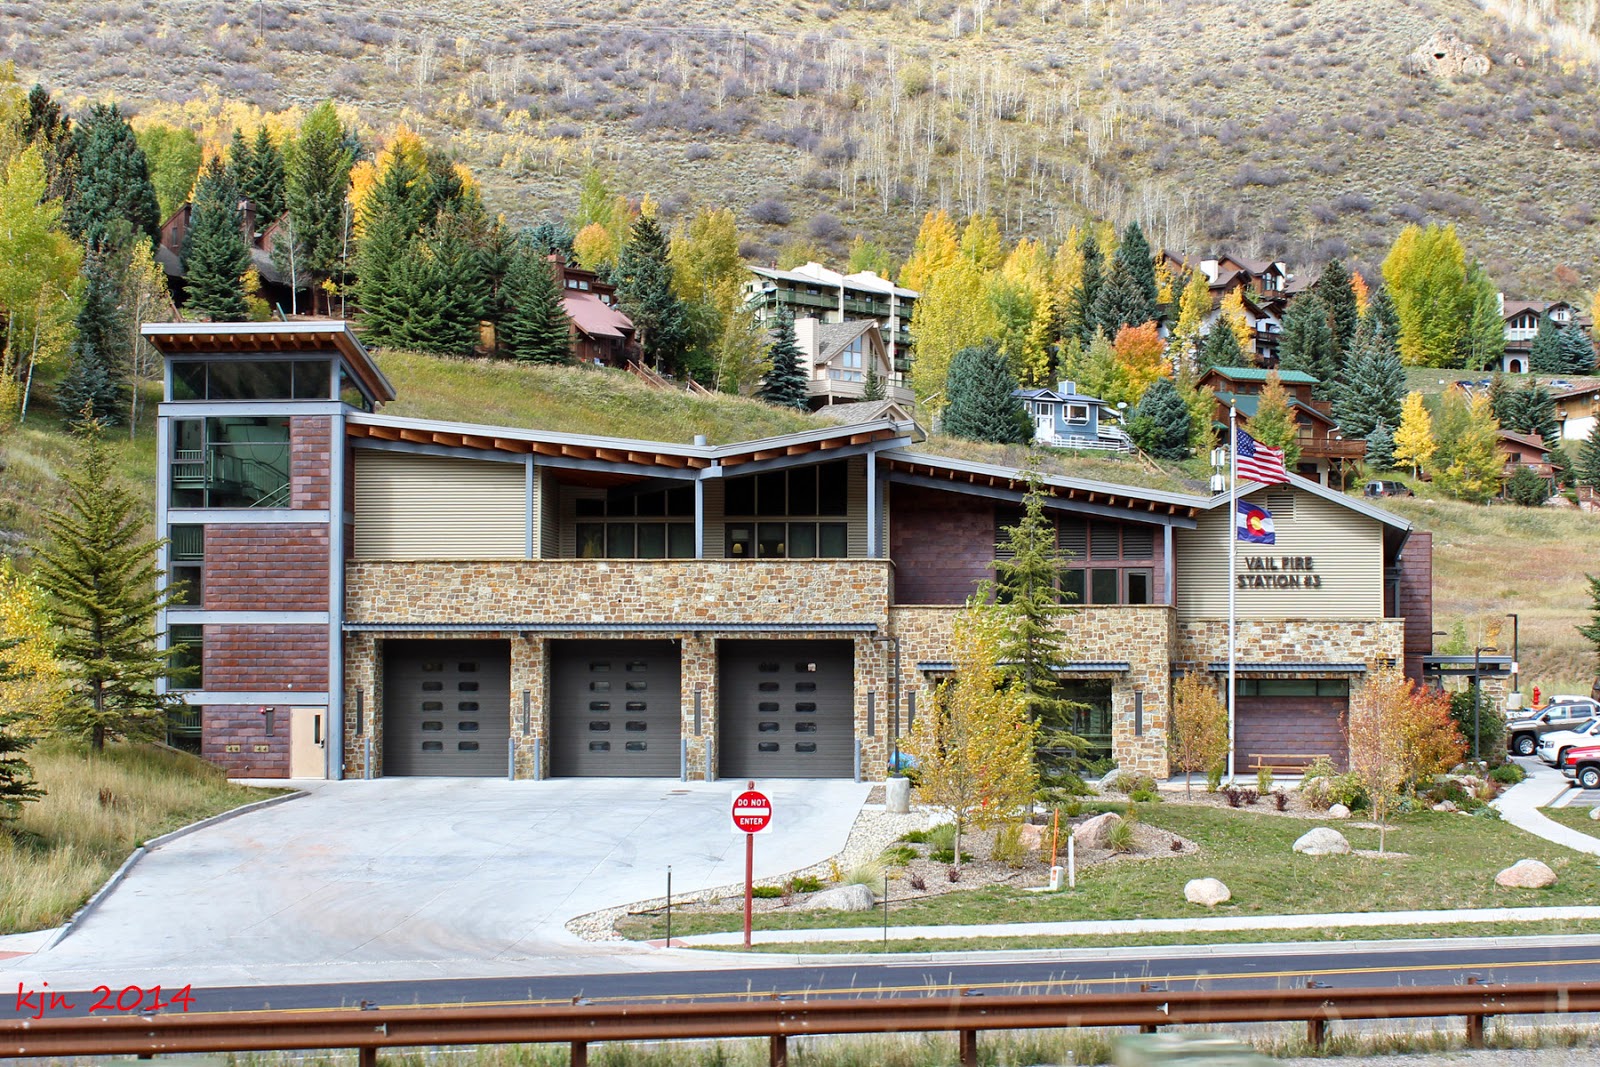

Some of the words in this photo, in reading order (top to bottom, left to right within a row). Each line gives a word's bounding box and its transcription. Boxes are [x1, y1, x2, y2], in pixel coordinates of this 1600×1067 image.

[1245, 556, 1277, 570] VAIL
[1281, 556, 1313, 570] FIRE
[1237, 574, 1299, 589] STATION
[1303, 574, 1320, 588] #3
